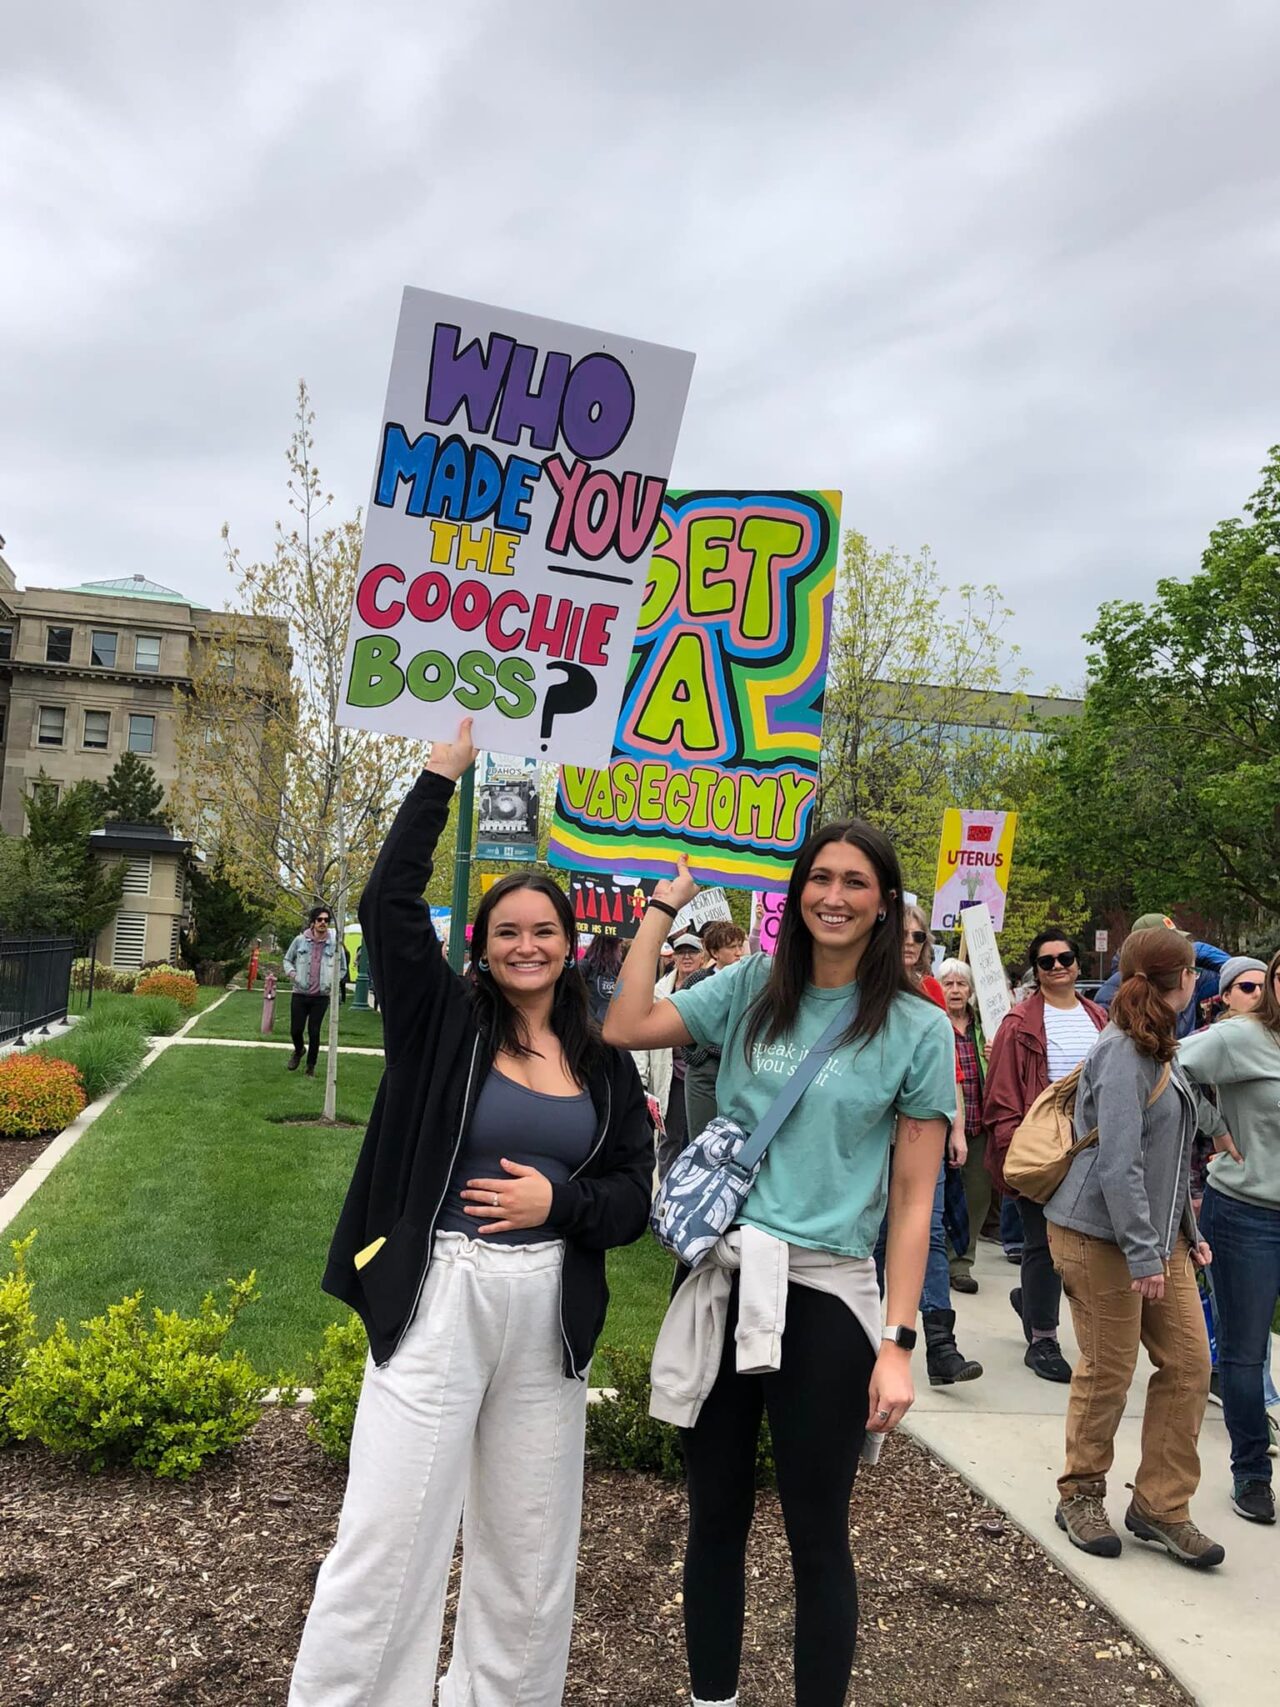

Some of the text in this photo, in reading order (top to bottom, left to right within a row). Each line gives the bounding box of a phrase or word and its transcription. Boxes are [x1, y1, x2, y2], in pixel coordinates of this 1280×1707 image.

[424, 322, 635, 461] WHO
[373, 421, 668, 564] MADE YOU
[428, 520, 521, 576] THE
[356, 563, 619, 666] COOCHIE
[346, 634, 598, 752] BOSS?
[633, 631, 720, 752] A
[562, 761, 815, 842] VASECTOMY
[947, 850, 1004, 868] UTERUS
[604, 926, 618, 936] EYE
[752, 1042, 796, 1061] speak
[754, 1056, 784, 1075] you
